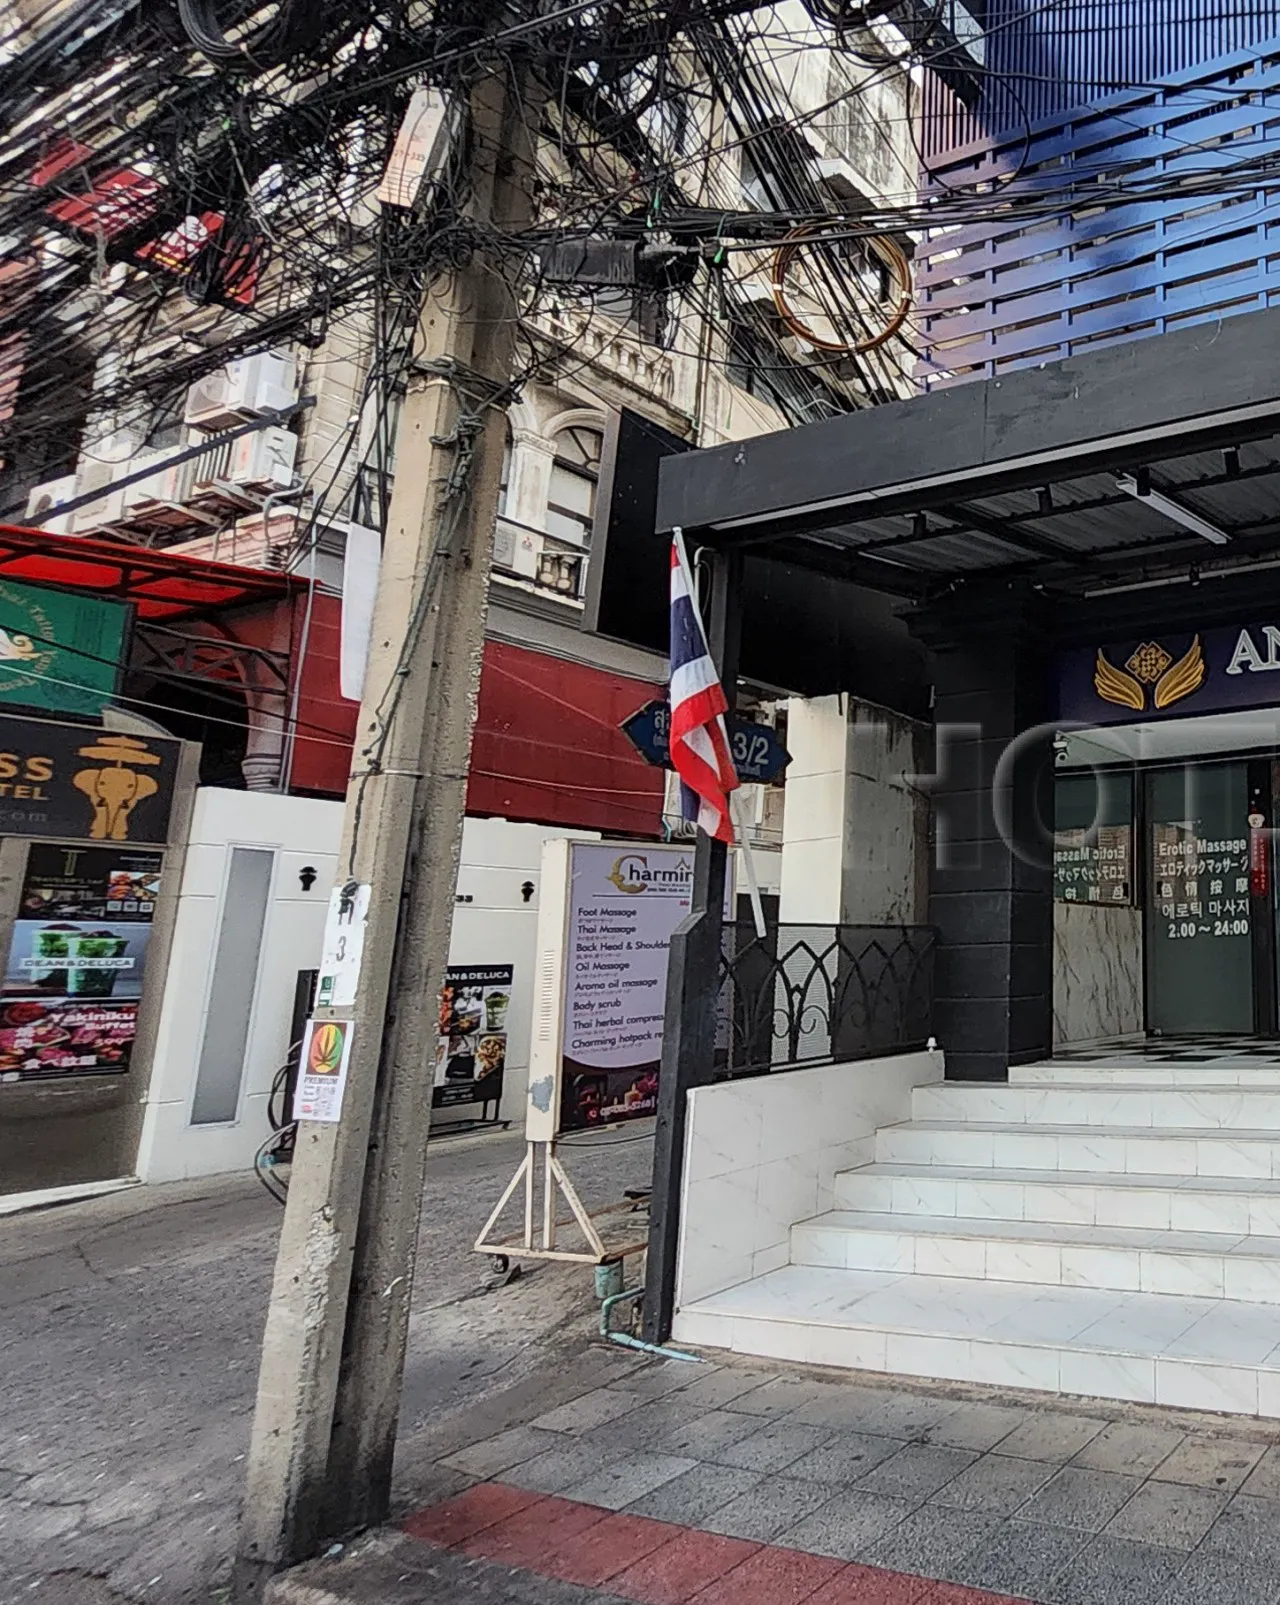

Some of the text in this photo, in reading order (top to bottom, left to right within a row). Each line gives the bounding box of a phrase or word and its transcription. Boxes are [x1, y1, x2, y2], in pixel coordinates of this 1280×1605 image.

[1159, 838, 1247, 856] Erotic Massage
[578, 908, 637, 918] Foot Massage
[577, 925, 637, 935] Thai Massage
[1214, 920, 1249, 936] 24:00
[576, 943, 598, 952] Back
[600, 942, 624, 951] Head
[626, 941, 633, 950] &
[575, 961, 630, 971] Oil Massage
[574, 979, 658, 991] Aroma oil massage
[573, 998, 622, 1012] Body scrub
[573, 1020, 593, 1031] Thai
[595, 1016, 623, 1028] herbal
[571, 1038, 617, 1050] Charming
[619, 1031, 652, 1044] hotpack
